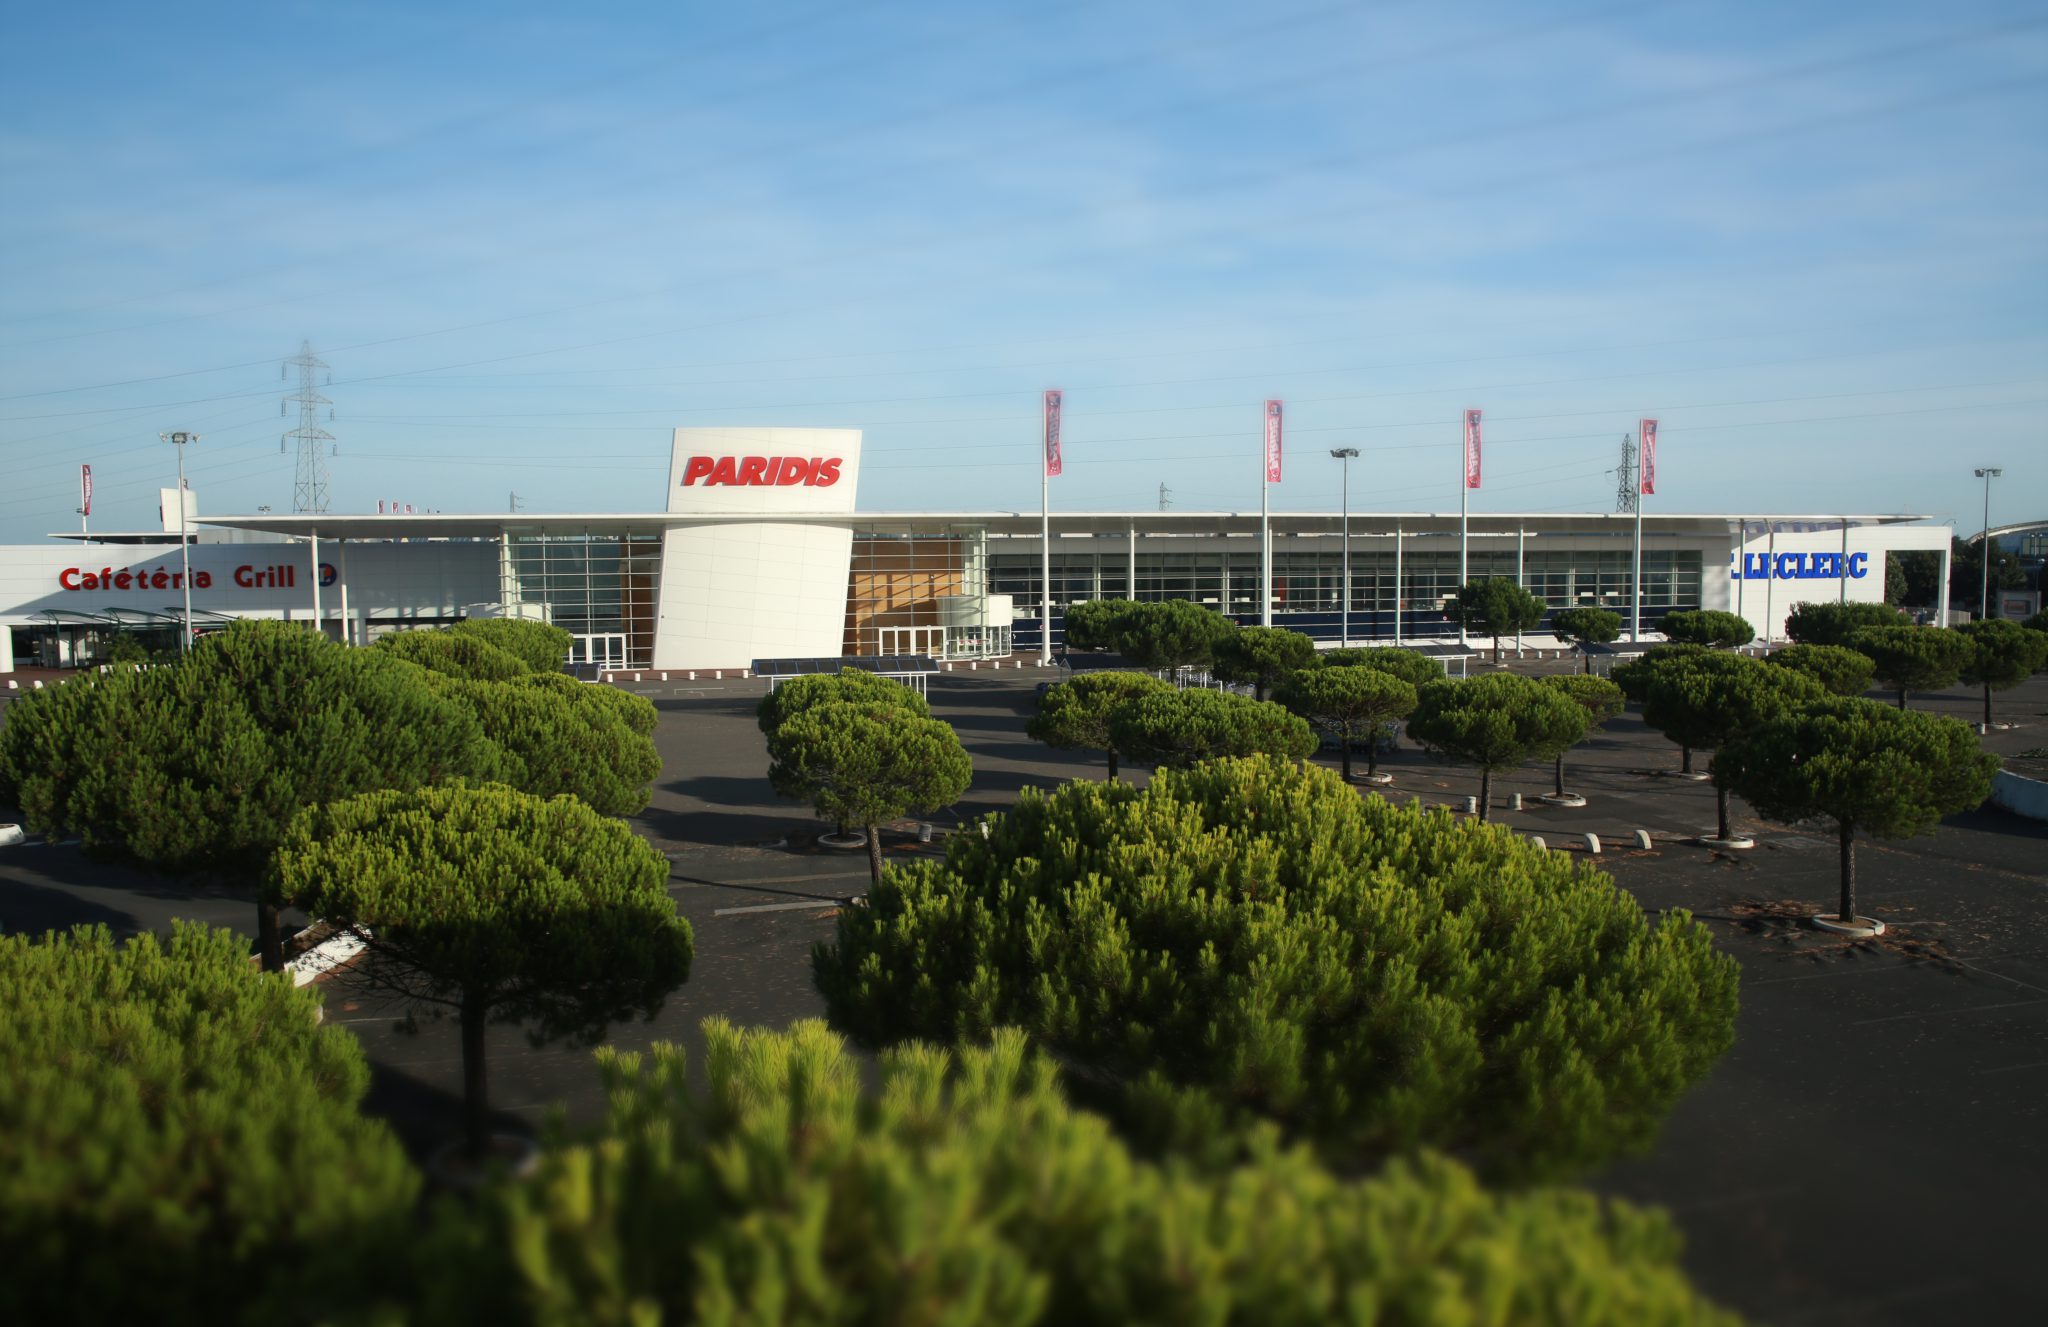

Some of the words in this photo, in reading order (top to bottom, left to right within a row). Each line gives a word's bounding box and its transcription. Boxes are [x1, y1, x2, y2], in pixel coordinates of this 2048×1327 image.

[682, 456, 843, 487] PARIDIS
[60, 566, 212, 591] Cafétéria
[234, 565, 295, 588] Grill
